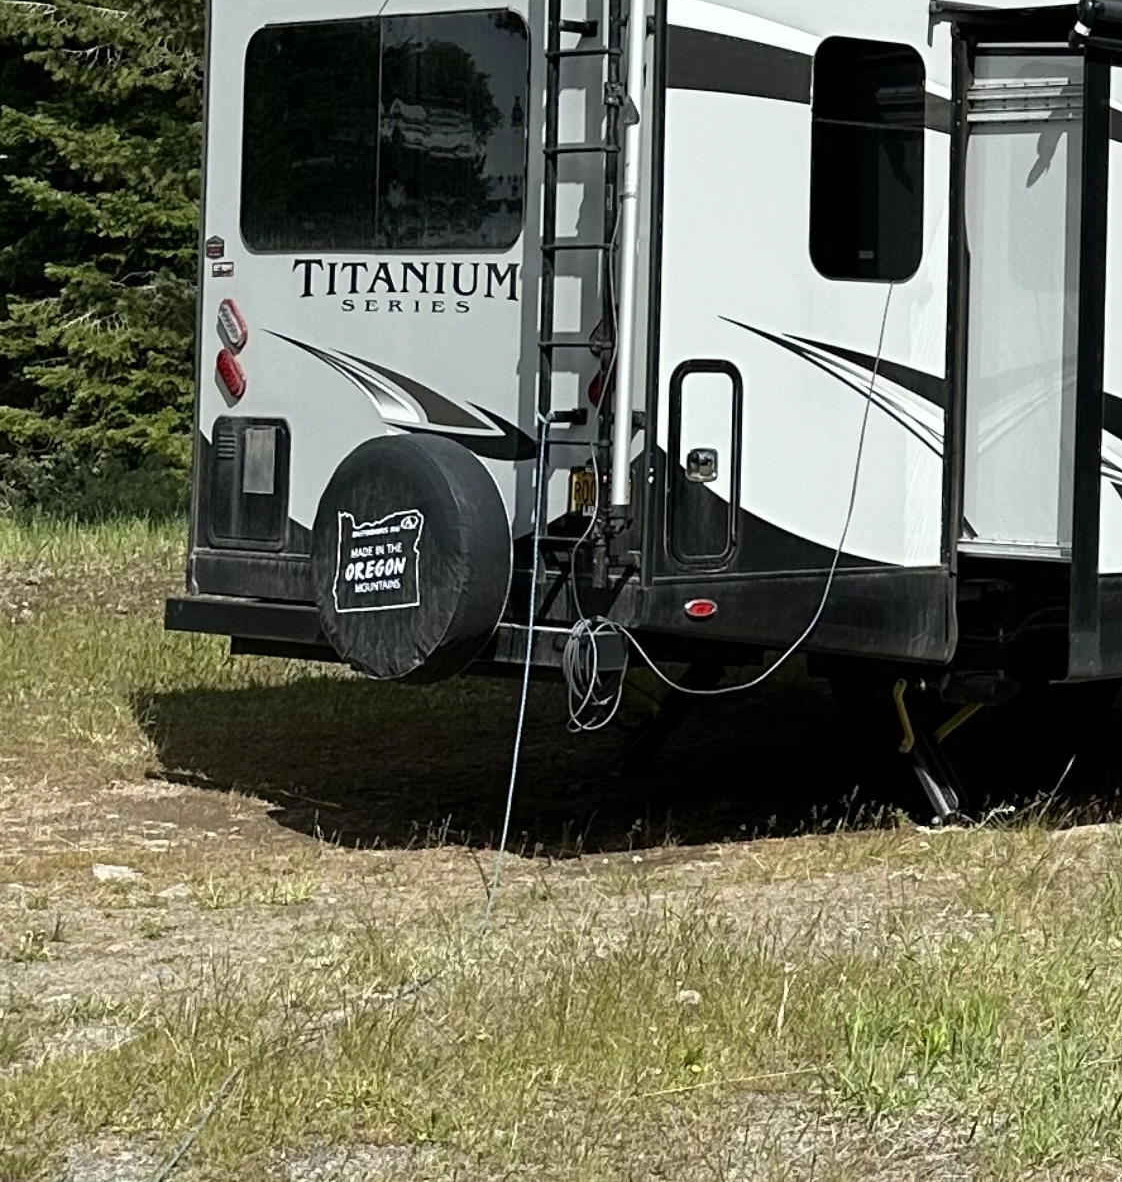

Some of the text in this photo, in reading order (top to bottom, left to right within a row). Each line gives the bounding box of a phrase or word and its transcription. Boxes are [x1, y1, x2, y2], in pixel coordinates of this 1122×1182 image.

[292, 259, 521, 302] TITANIUM
[341, 299, 470, 314] SERIES
[350, 542, 403, 558] MADE IN THE
[344, 556, 407, 582] OREGON
